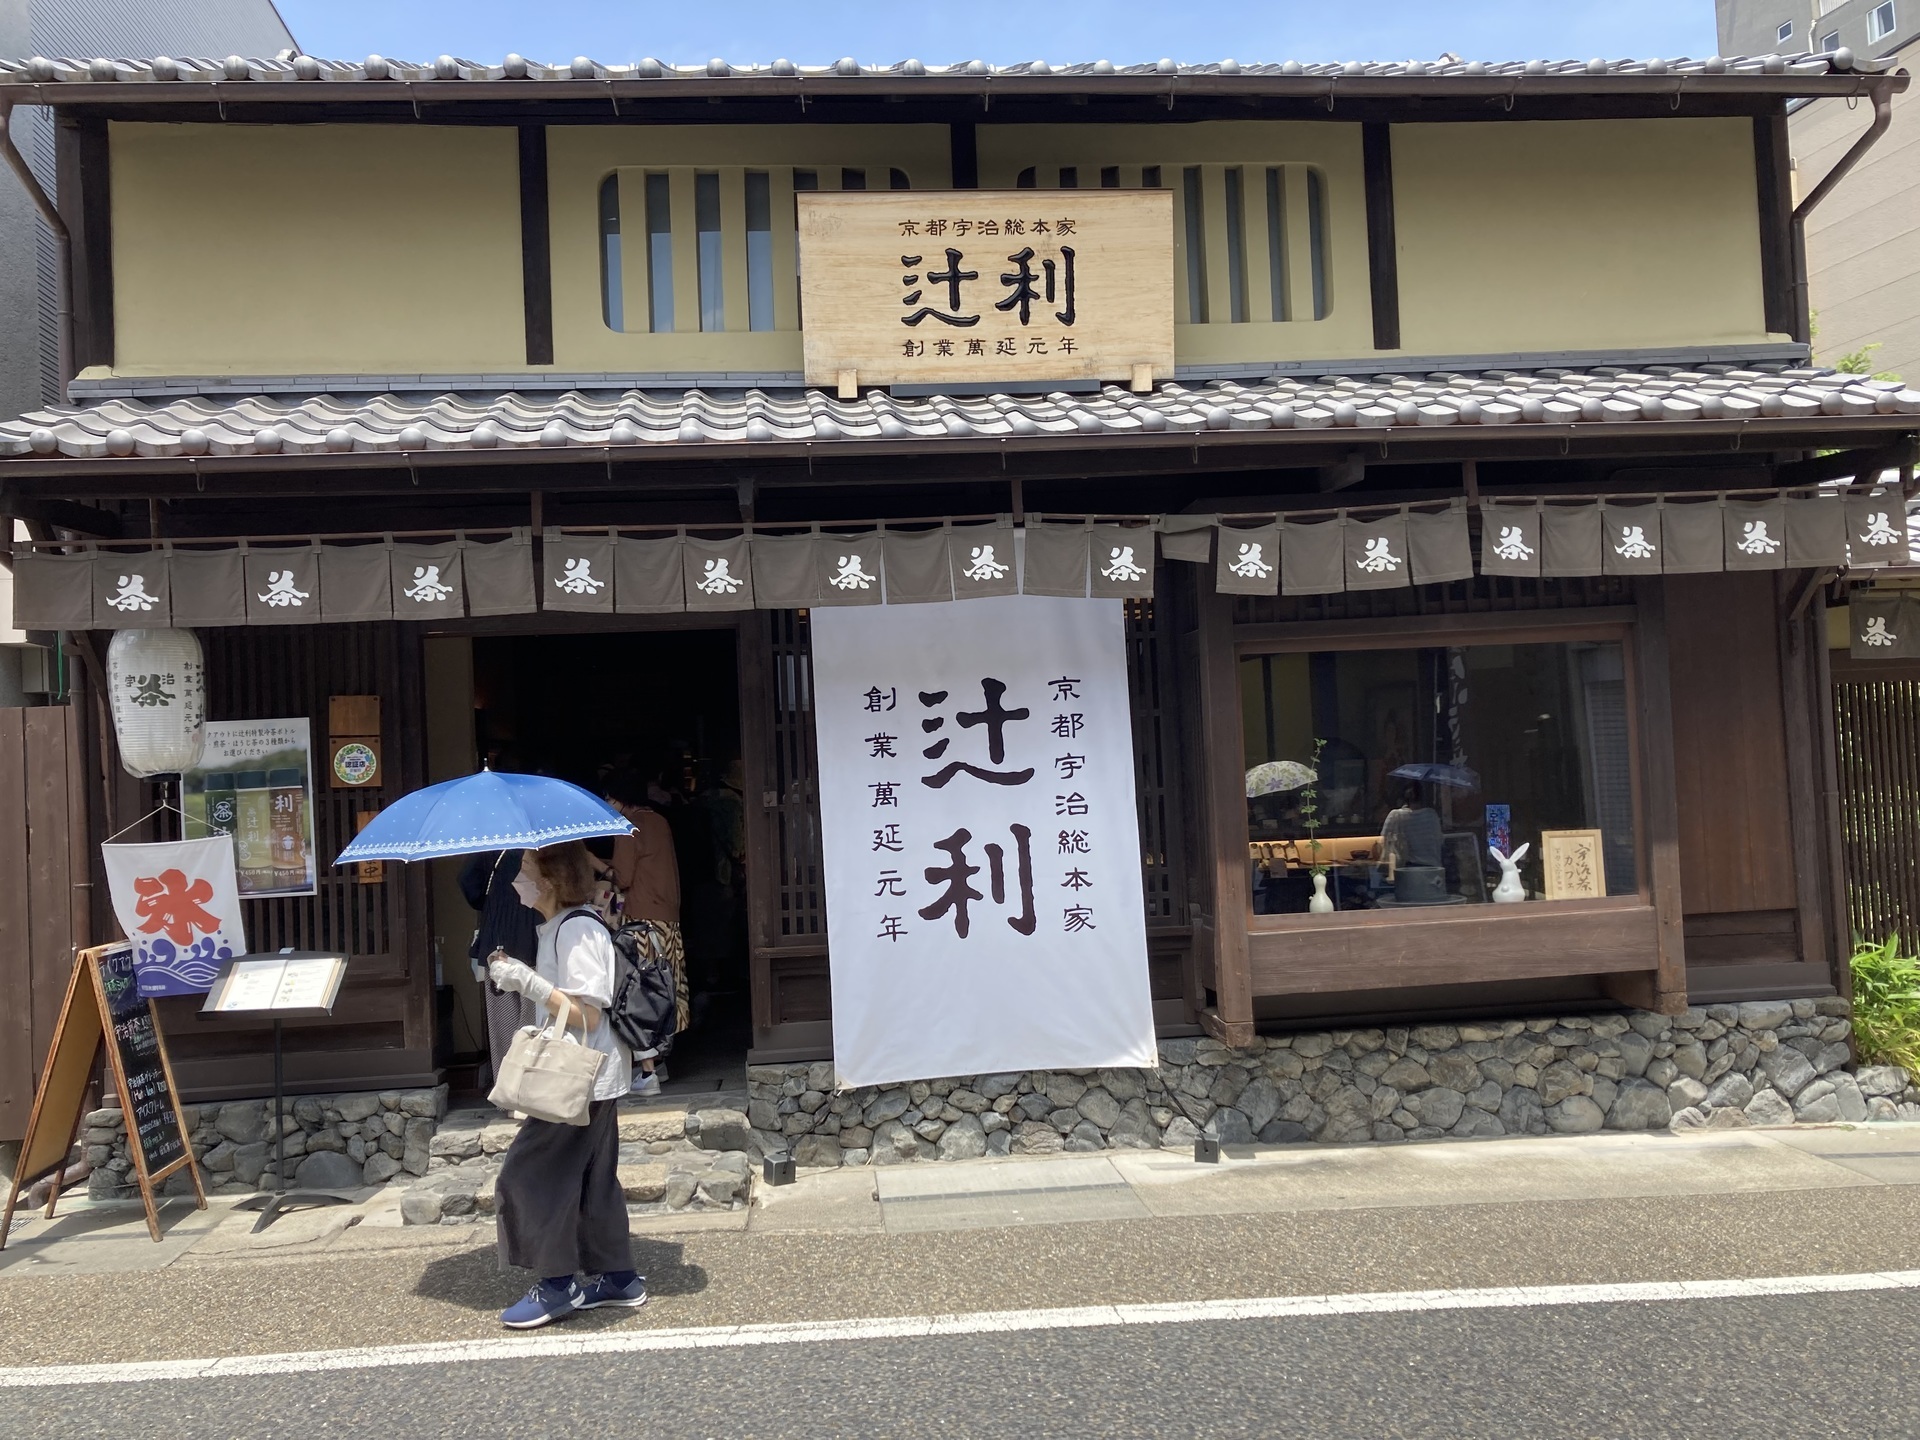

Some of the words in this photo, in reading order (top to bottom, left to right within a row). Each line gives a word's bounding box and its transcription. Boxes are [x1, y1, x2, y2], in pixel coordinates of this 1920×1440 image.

[899, 218, 1077, 237] 京都宇治総本家
[901, 246, 1076, 327] 辻利
[902, 336, 1078, 357] 創業萬延元年
[864, 686, 908, 942] 創業萬延元年
[918, 678, 1036, 938] 辻利
[1048, 676, 1096, 931] 京都宇治総本家
[133, 868, 222, 946] 氷
